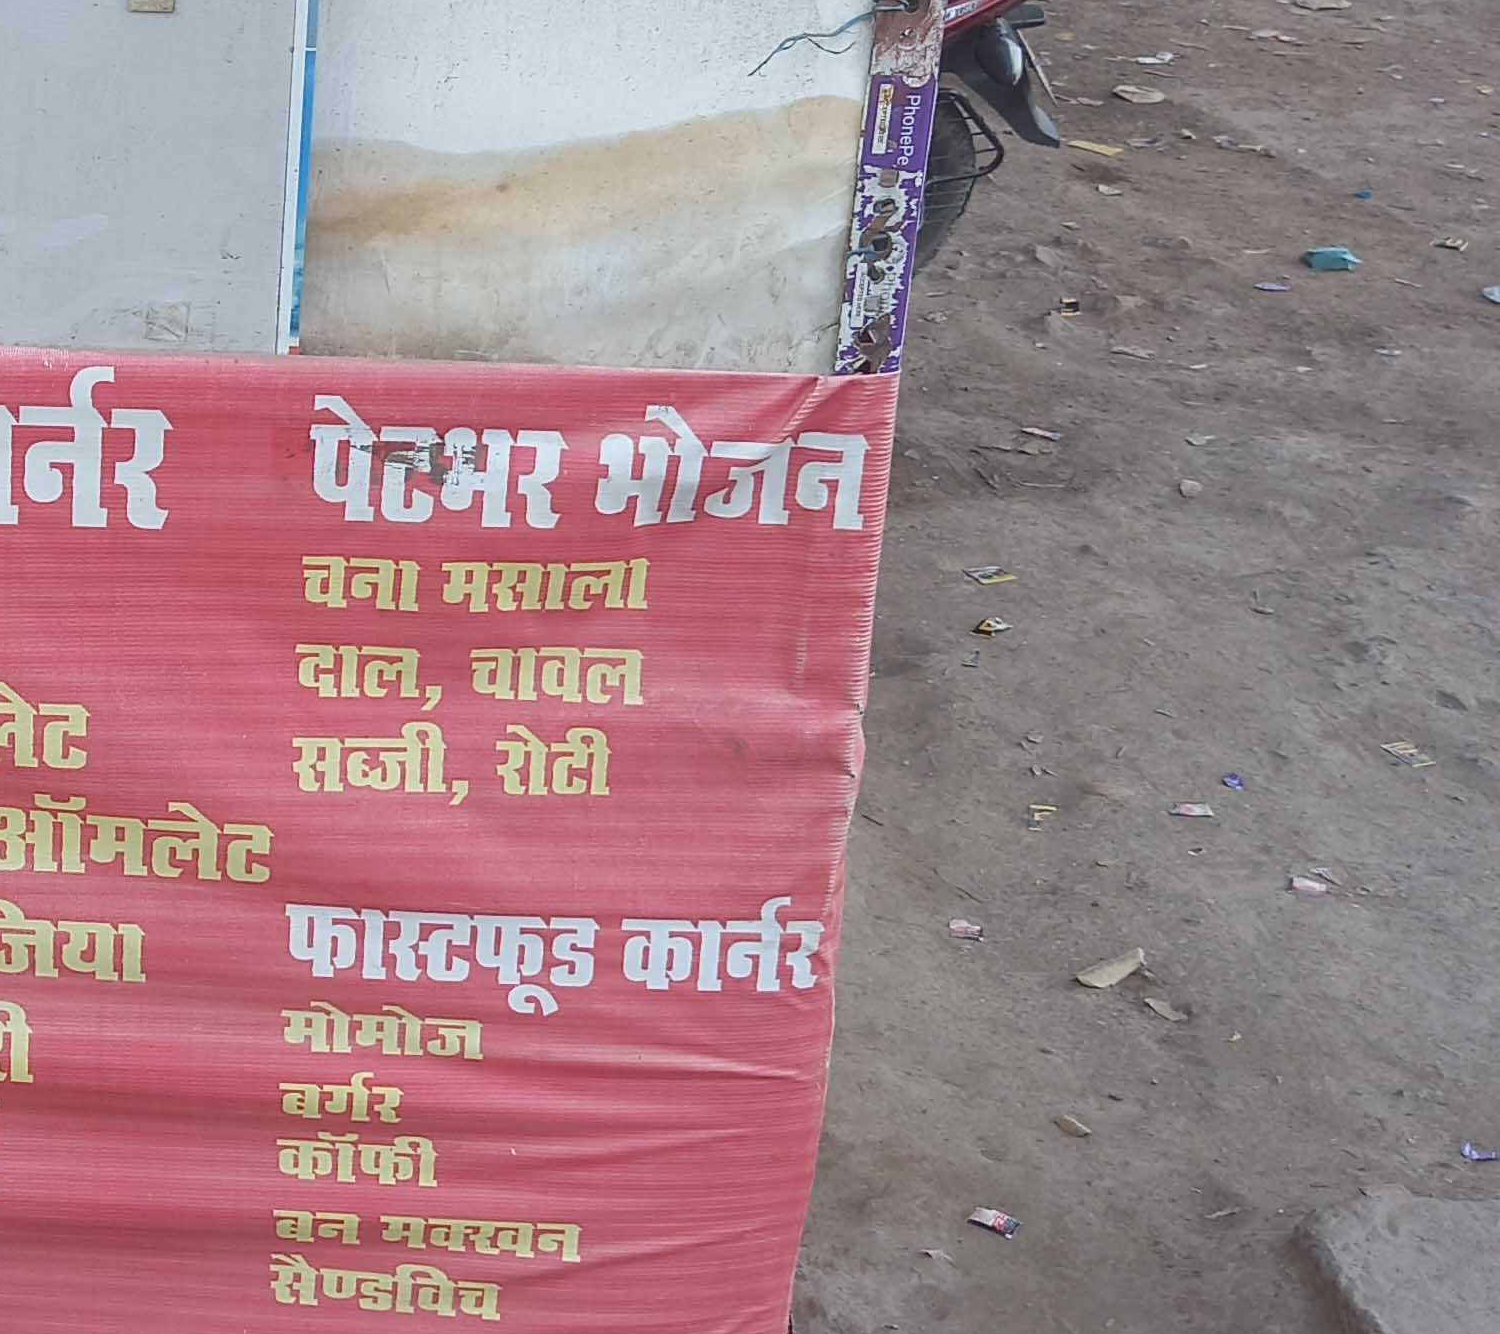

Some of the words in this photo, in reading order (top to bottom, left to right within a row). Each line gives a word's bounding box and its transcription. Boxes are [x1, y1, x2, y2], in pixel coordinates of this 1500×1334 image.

[896, 94, 922, 166] PhonePe
[308, 394, 569, 529] पेटभर
[593, 404, 871, 531] भोजन
[302, 555, 420, 612] चना
[442, 558, 650, 611] मसाला
[295, 643, 443, 710] दाल,
[470, 647, 644, 706] चावल
[496, 723, 613, 796] रोटी
[284, 903, 601, 1017] फास्टफूड
[621, 896, 826, 992] कार्नर
[280, 1001, 484, 1060] मोमोज
[278, 1072, 405, 1123] बर्गर
[276, 1131, 438, 1188] कॉफी
[272, 1209, 360, 1245] बन
[269, 1253, 503, 1321] सैण्डविच
